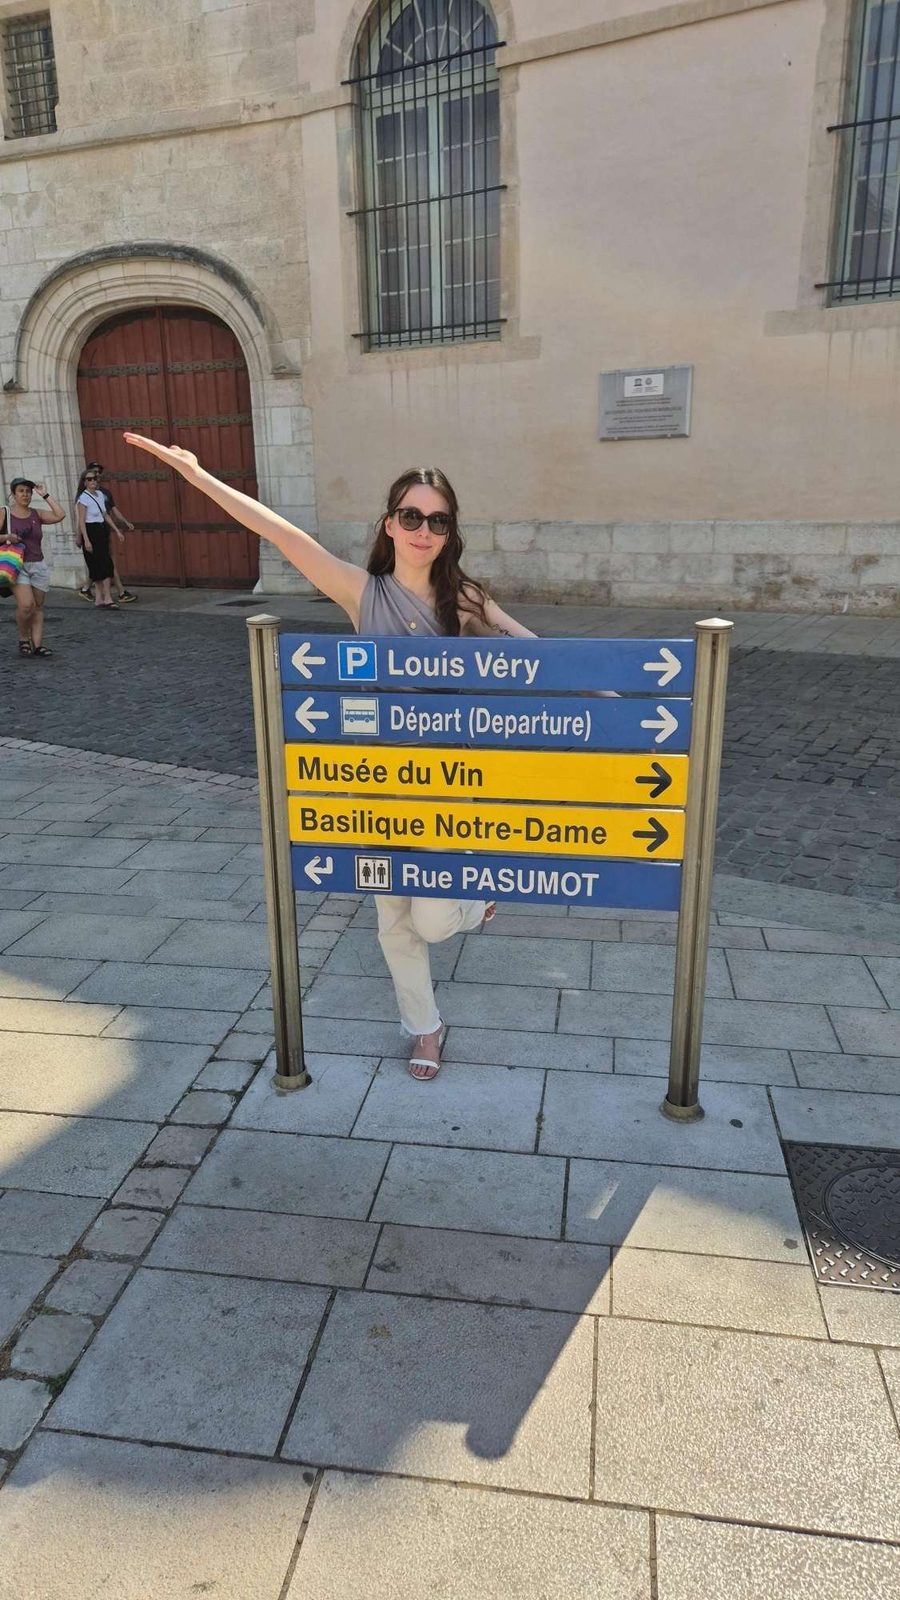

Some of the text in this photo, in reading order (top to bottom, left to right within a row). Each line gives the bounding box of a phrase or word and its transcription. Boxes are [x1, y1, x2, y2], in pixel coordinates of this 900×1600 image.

[346, 647, 368, 675] P
[475, 652, 539, 684] Véry
[390, 706, 591, 741] Départ (Departure)
[299, 756, 482, 786] Musée du Vin
[300, 808, 606, 844] Basilique Notre-Dame
[403, 864, 599, 896] Rue PASUMOT
